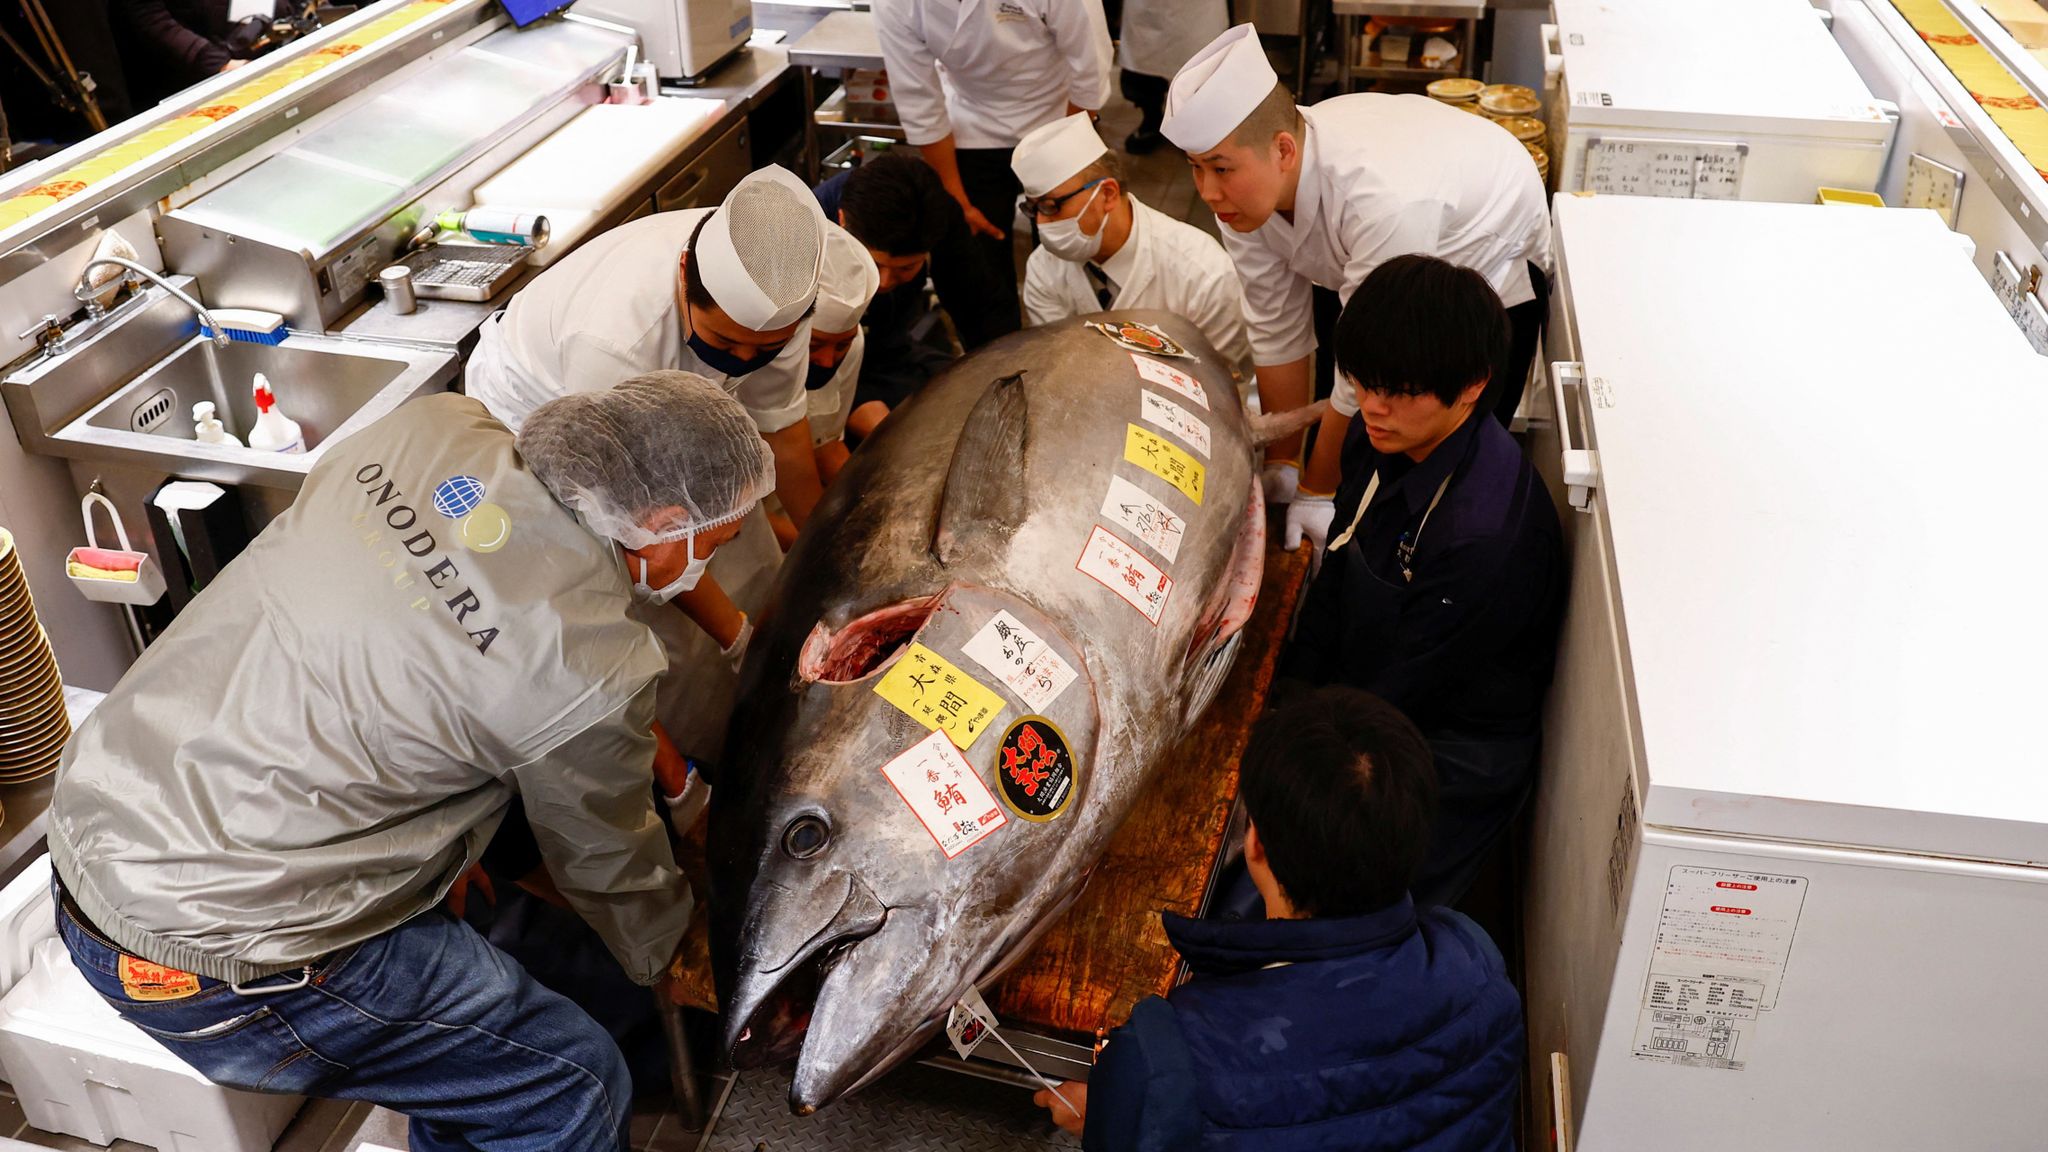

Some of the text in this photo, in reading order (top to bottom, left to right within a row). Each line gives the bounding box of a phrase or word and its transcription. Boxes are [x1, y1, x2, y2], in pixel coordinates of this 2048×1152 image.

[1140, 444, 1187, 479] 大間
[351, 512, 431, 611] GROUP
[356, 463, 501, 657] ONODERA
[993, 619, 1035, 656] 銀座
[914, 653, 957, 685] 青森県
[1001, 645, 1053, 693] おのでら
[909, 672, 969, 718] 大間
[931, 742, 963, 779] 令和七年
[1001, 723, 1044, 778] 大間
[916, 758, 968, 816] 一番鮪
[1681, 867, 1798, 886] スーパーフリーザーご使用上の注意
